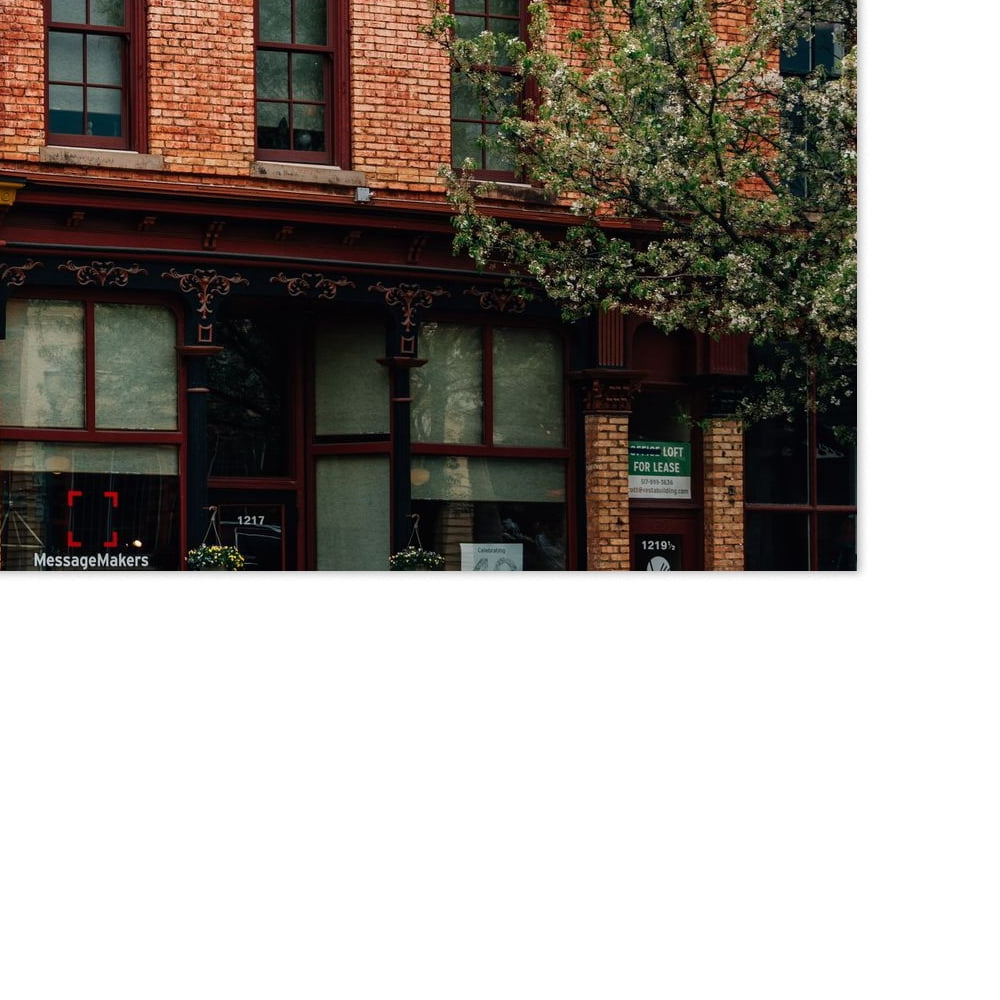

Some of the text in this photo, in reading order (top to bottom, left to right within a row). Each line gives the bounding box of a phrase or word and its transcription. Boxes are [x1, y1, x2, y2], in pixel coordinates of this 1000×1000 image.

[662, 446, 684, 457] LOFT
[633, 461, 680, 473] FOR LEASE
[237, 515, 265, 525] 1217
[33, 552, 149, 570] MessageMakers
